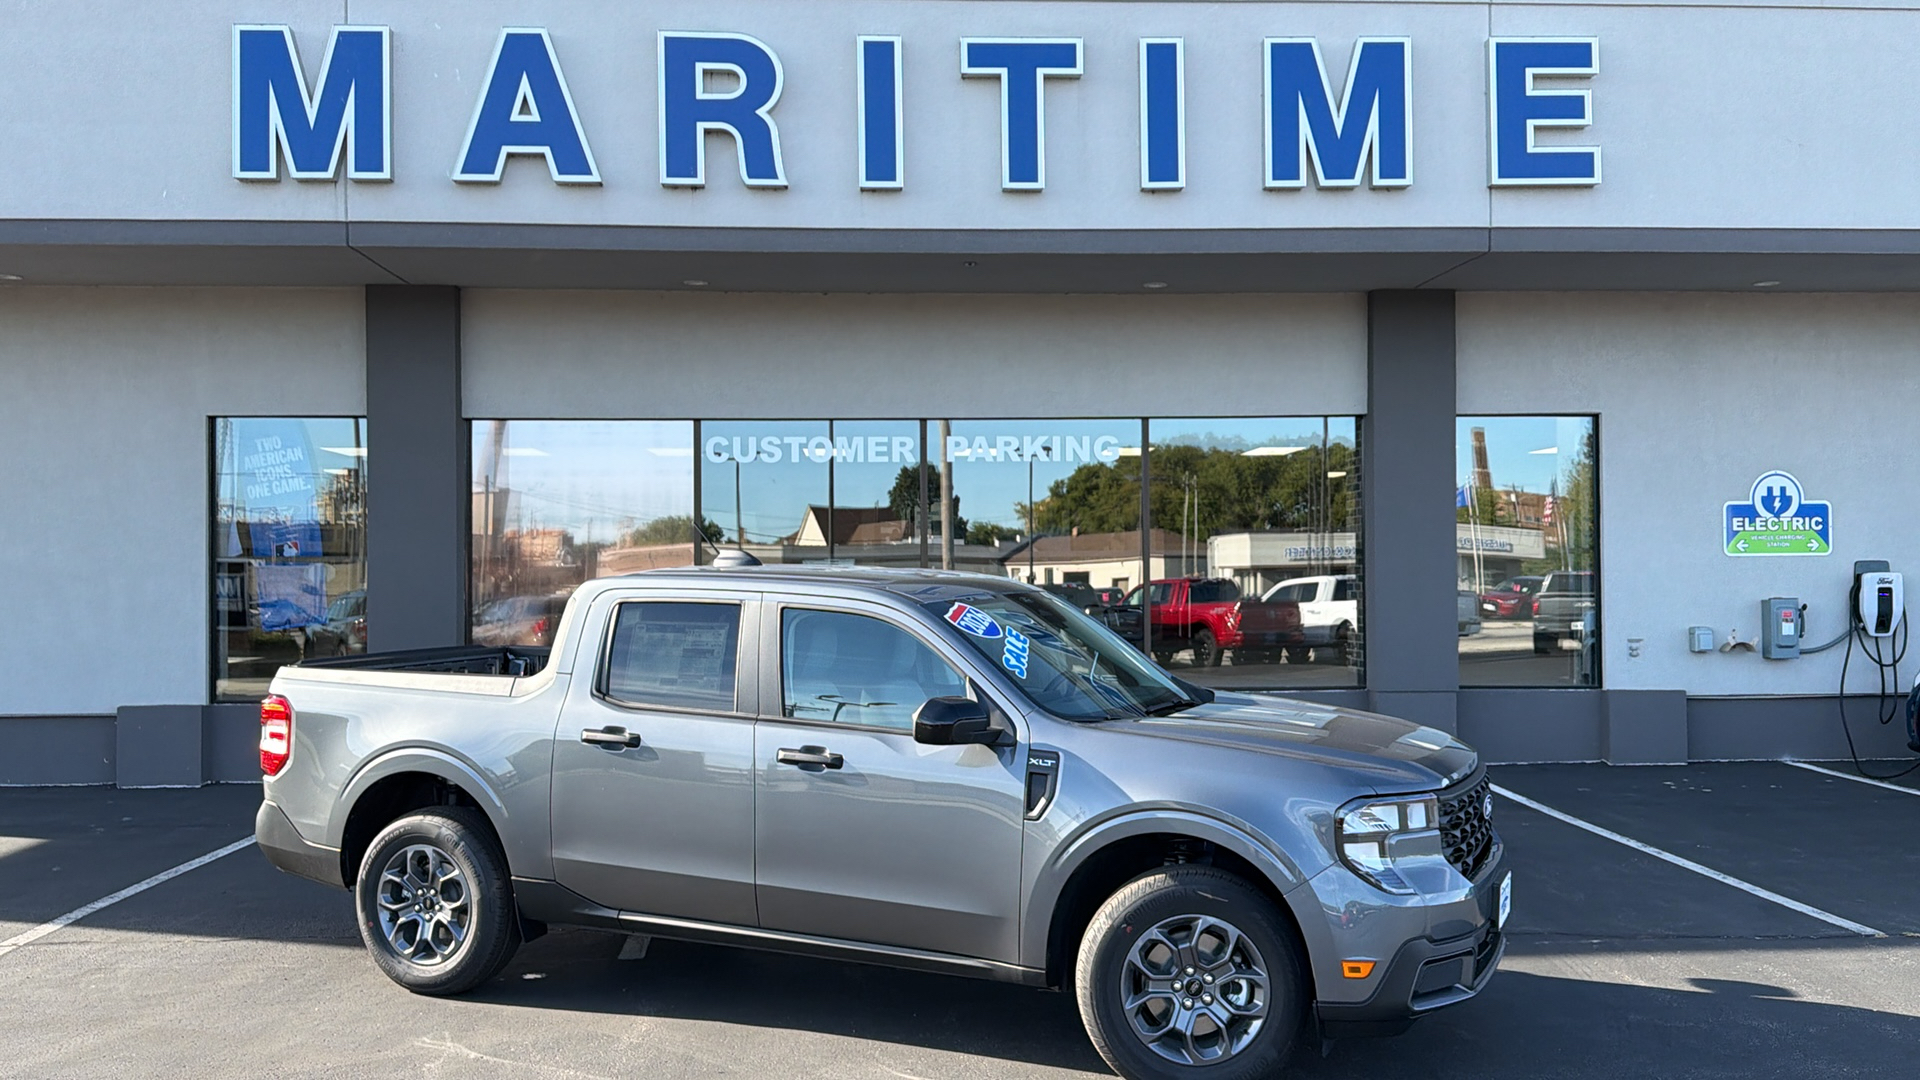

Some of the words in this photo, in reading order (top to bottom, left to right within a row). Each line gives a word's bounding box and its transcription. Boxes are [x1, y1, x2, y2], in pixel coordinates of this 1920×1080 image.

[232, 24, 1601, 192] MARITIME
[254, 435, 282, 452] TWO
[705, 435, 916, 463] CUSTOMER
[945, 435, 1121, 463] PARKING
[244, 446, 304, 470] AMERICAN
[254, 464, 296, 483] ICONS.
[246, 482, 272, 500] ONE
[272, 477, 312, 496] GAME.
[1732, 517, 1824, 531] ELECTRIC
[1876, 577, 1894, 585] Ford
[959, 608, 992, 635] 2026
[1002, 625, 1030, 680] SALE
[1029, 758, 1056, 767] XLT
